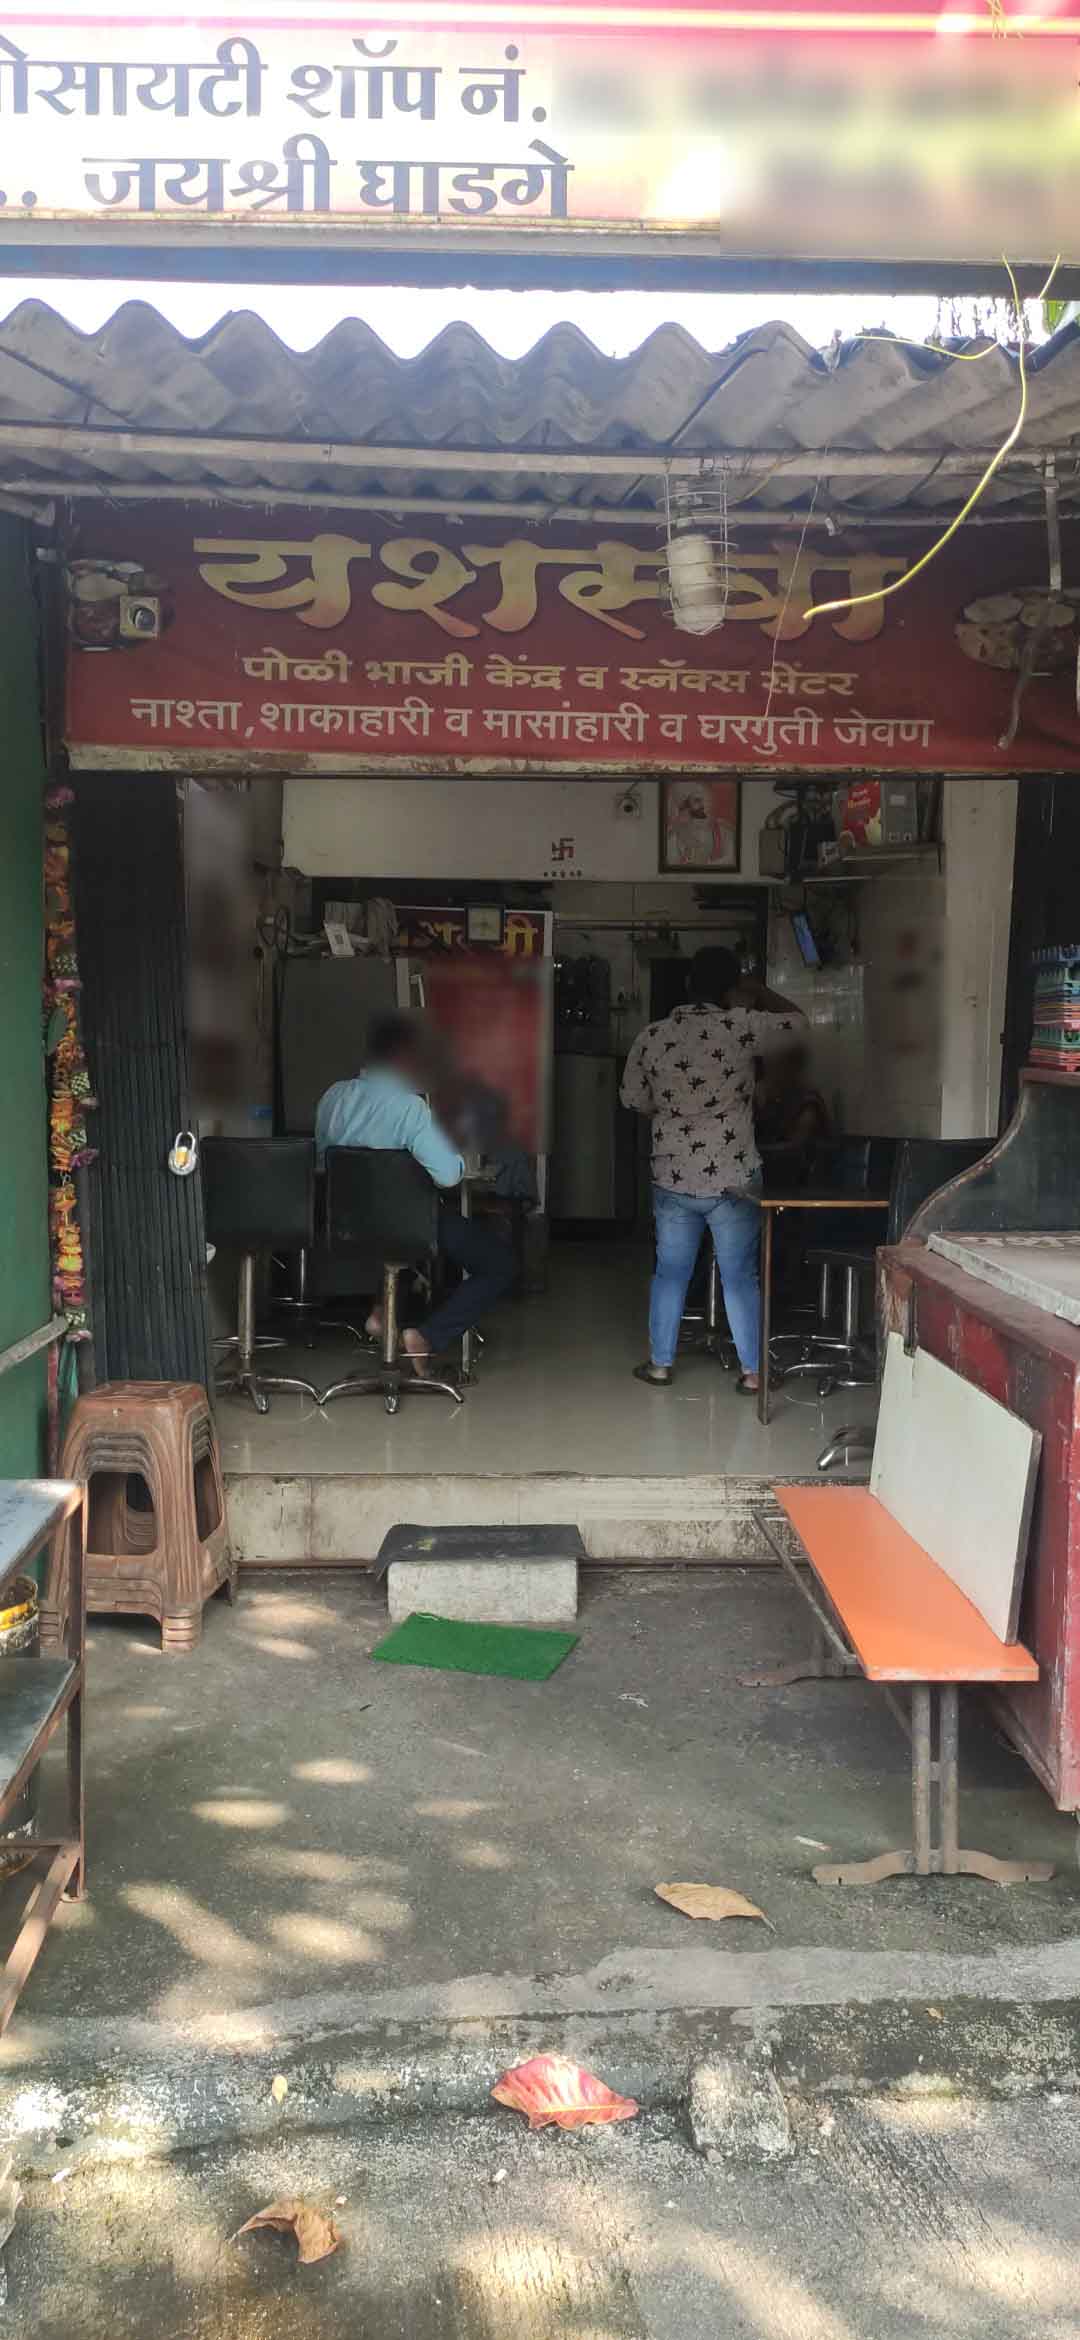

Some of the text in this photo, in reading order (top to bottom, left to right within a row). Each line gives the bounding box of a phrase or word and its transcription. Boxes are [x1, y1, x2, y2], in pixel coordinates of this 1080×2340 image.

[0, 34, 268, 117] ोसायटी
[286, 38, 442, 120] शॉप
[82, 133, 337, 212] जयश्री
[356, 138, 575, 217] घाडगे
[242, 647, 859, 696] पोळी भाजी केंद्र व स्नॅक्स सेंटर
[444, 708, 473, 737] व
[483, 701, 650, 743] मासांहारी
[659, 714, 688, 743] व
[698, 706, 824, 755] घरगुती
[833, 708, 935, 747] जेवण
